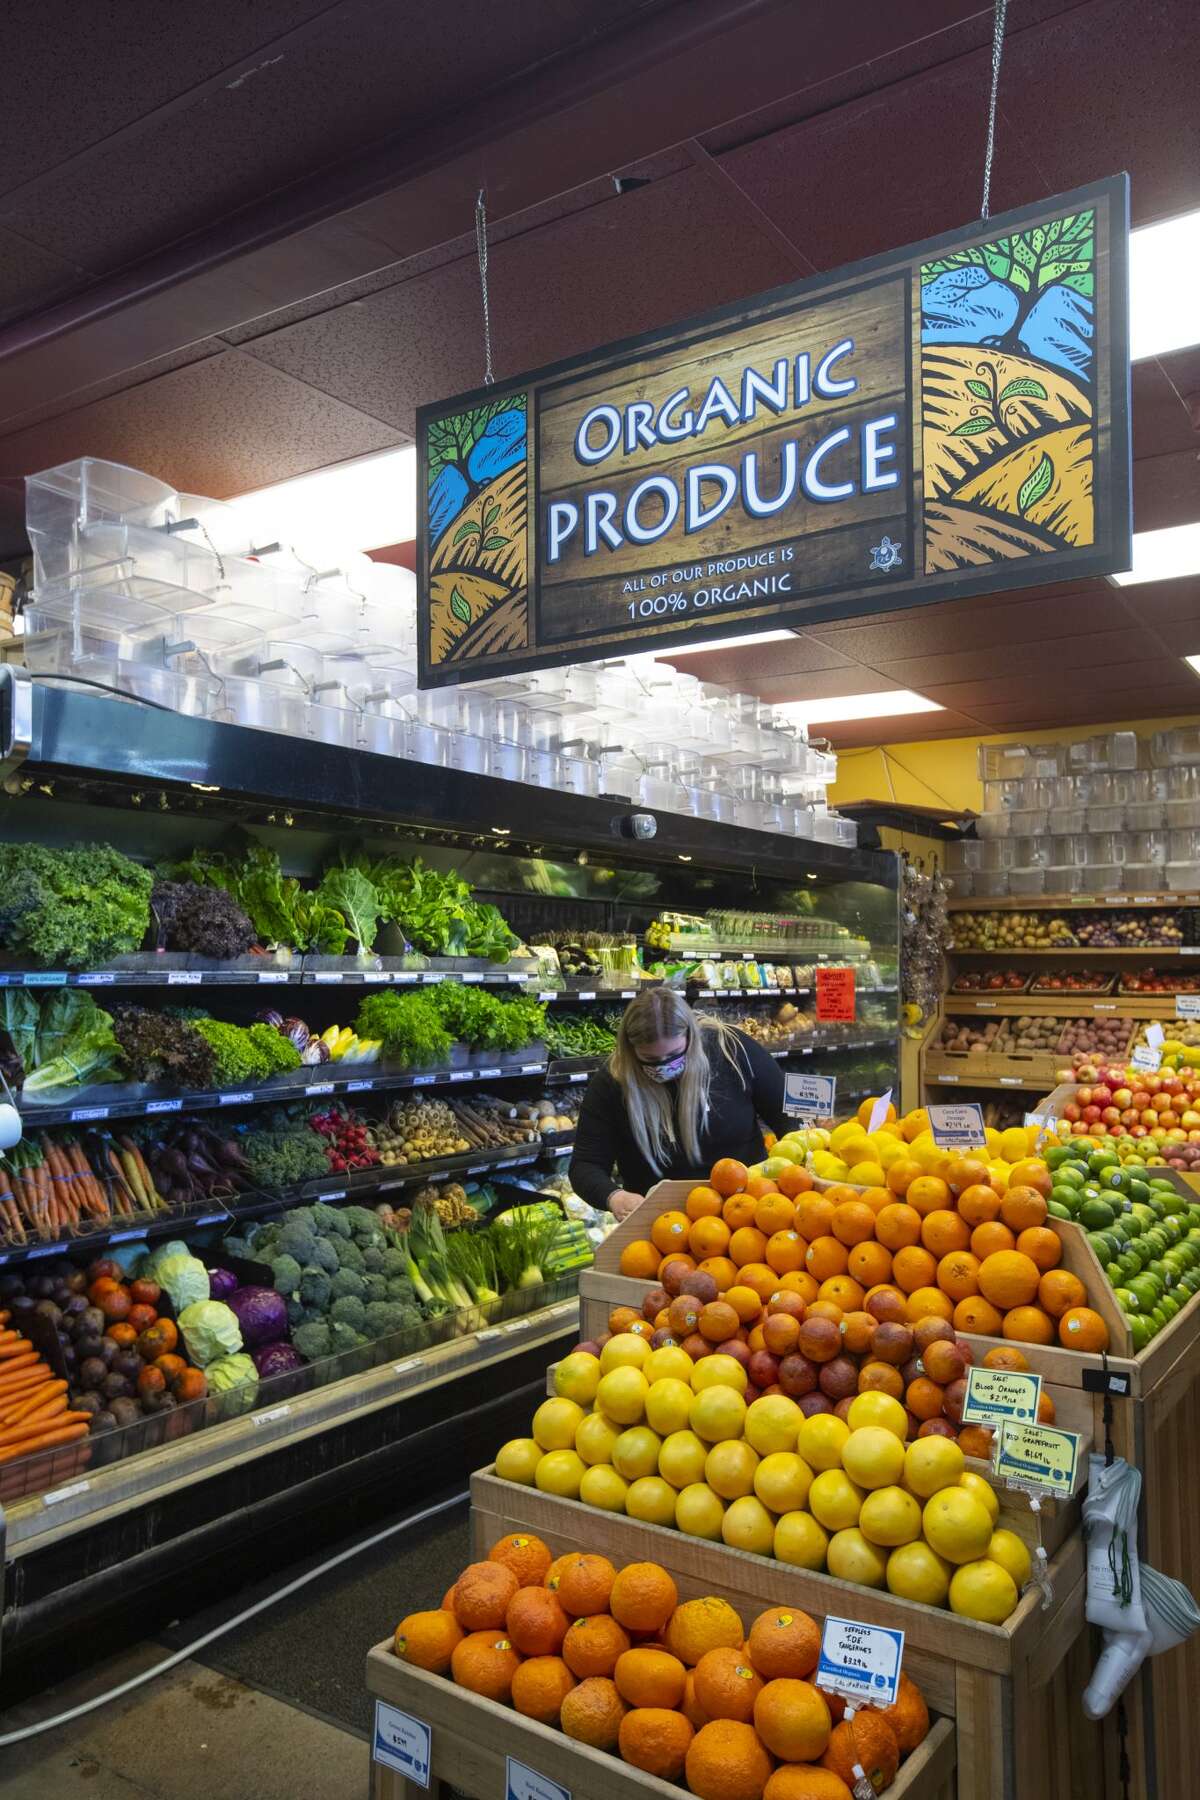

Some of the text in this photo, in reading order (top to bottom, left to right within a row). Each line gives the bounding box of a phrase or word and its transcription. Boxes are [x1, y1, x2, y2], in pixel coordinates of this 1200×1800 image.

[575, 338, 857, 464] ORGANIC
[547, 413, 900, 564] PRODUCE
[623, 547, 793, 593] ALL OF OUR PRODUCE IS
[628, 573, 791, 619] 100% ORGANIC
